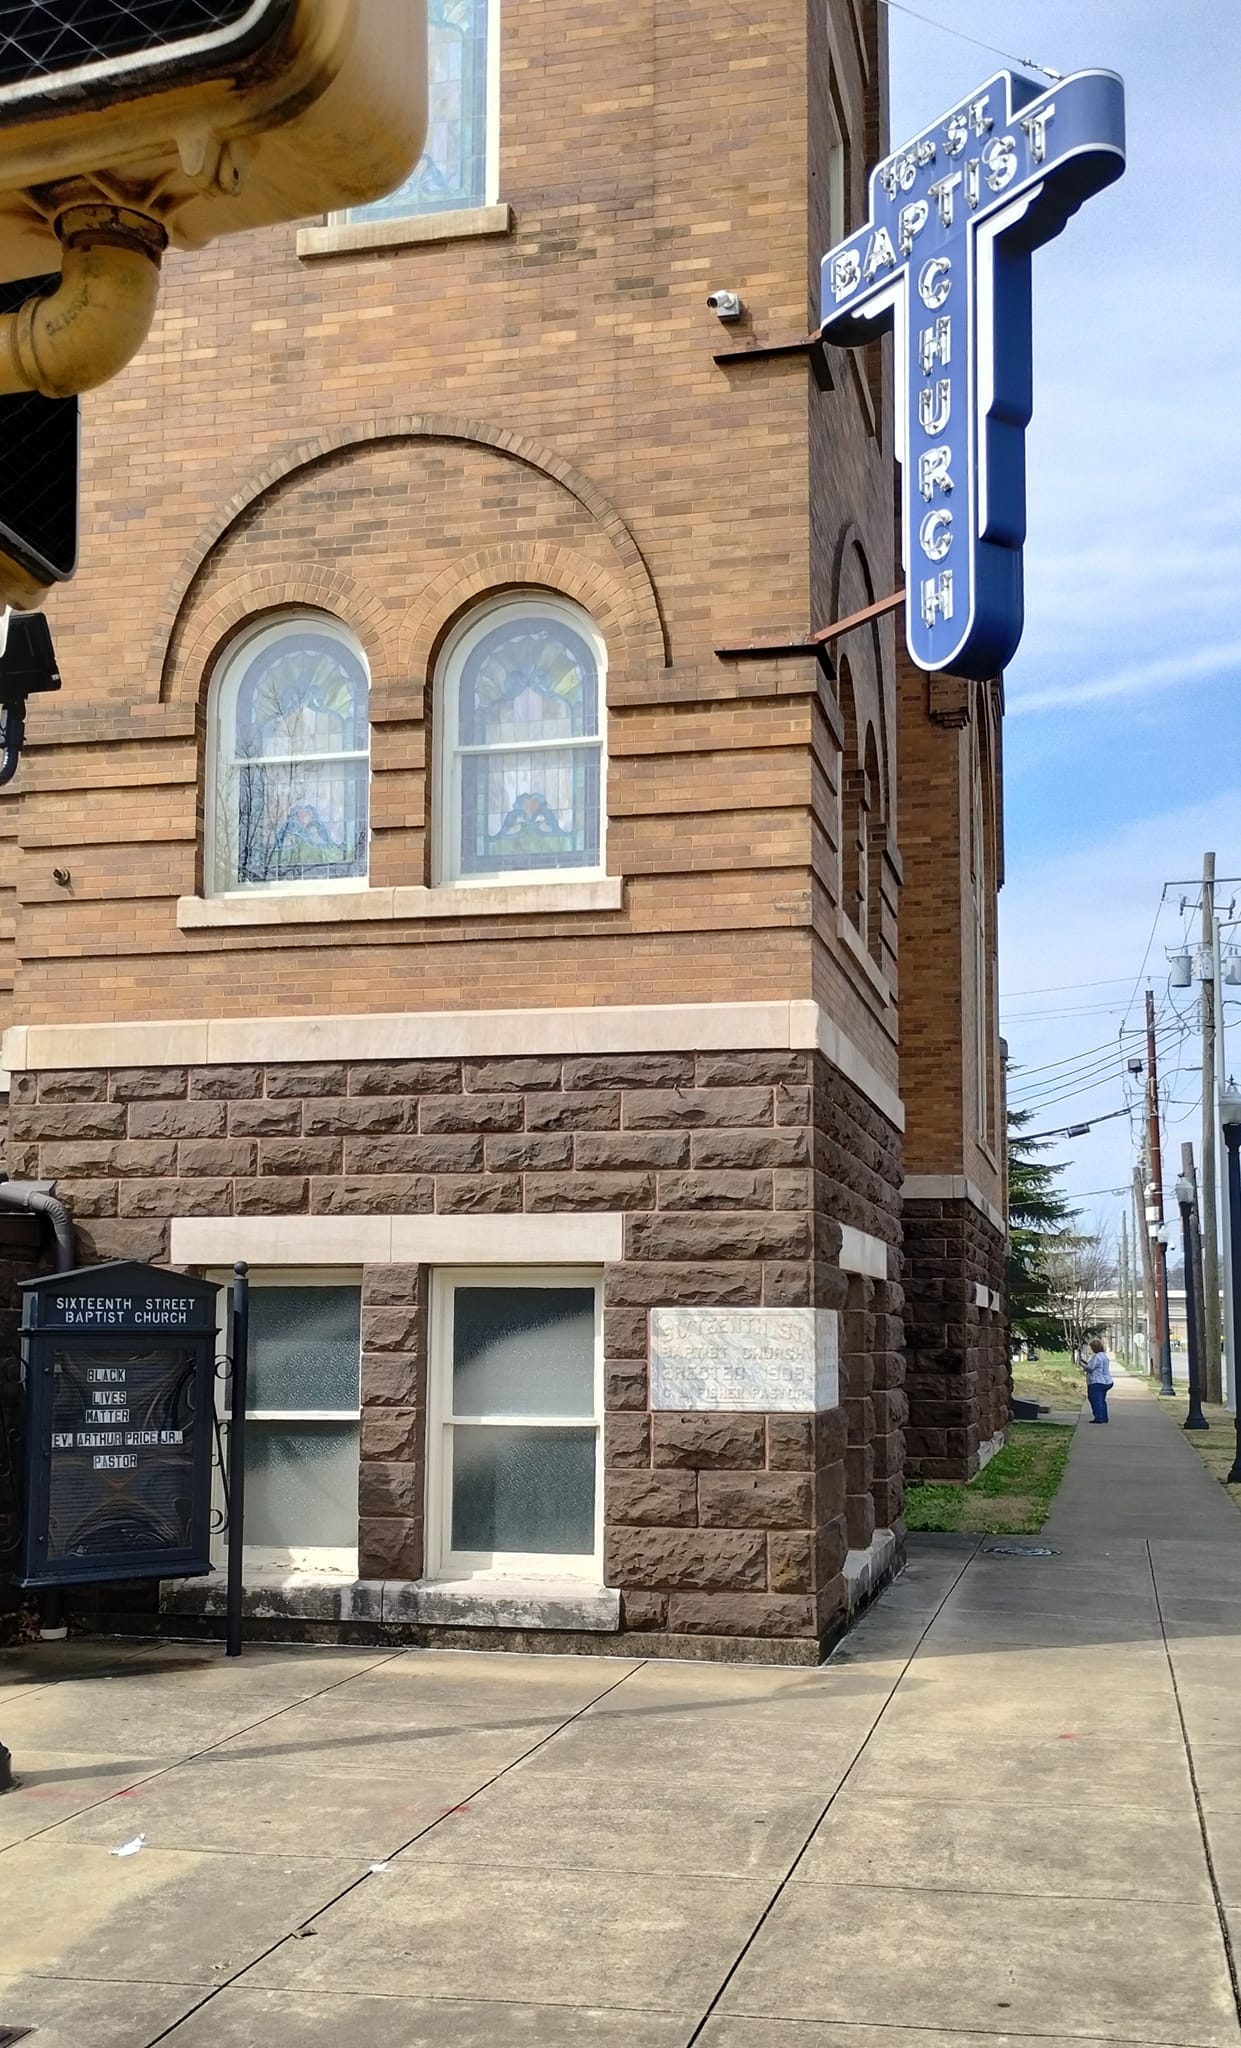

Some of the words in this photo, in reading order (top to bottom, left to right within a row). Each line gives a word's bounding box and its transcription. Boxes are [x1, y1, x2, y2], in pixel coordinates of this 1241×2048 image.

[831, 103, 1056, 303] BAPTIST
[918, 256, 954, 629] CHURCH
[56, 1297, 132, 1310] SIXTEENTH
[145, 1298, 196, 1310] STREET
[65, 1311, 125, 1323] BAPTIST
[134, 1312, 187, 1323] CHURCH
[662, 1345, 728, 1360] BAPTIST
[742, 1345, 805, 1360] CHURCH
[88, 1369, 125, 1382] BLACK
[662, 1365, 745, 1381] ERECTED
[93, 1391, 126, 1405] LIVES
[86, 1409, 129, 1423] MATTER
[77, 1432, 122, 1446] ARTHUR
[125, 1431, 158, 1445] PRICE
[93, 1454, 137, 1469] PASTOR
